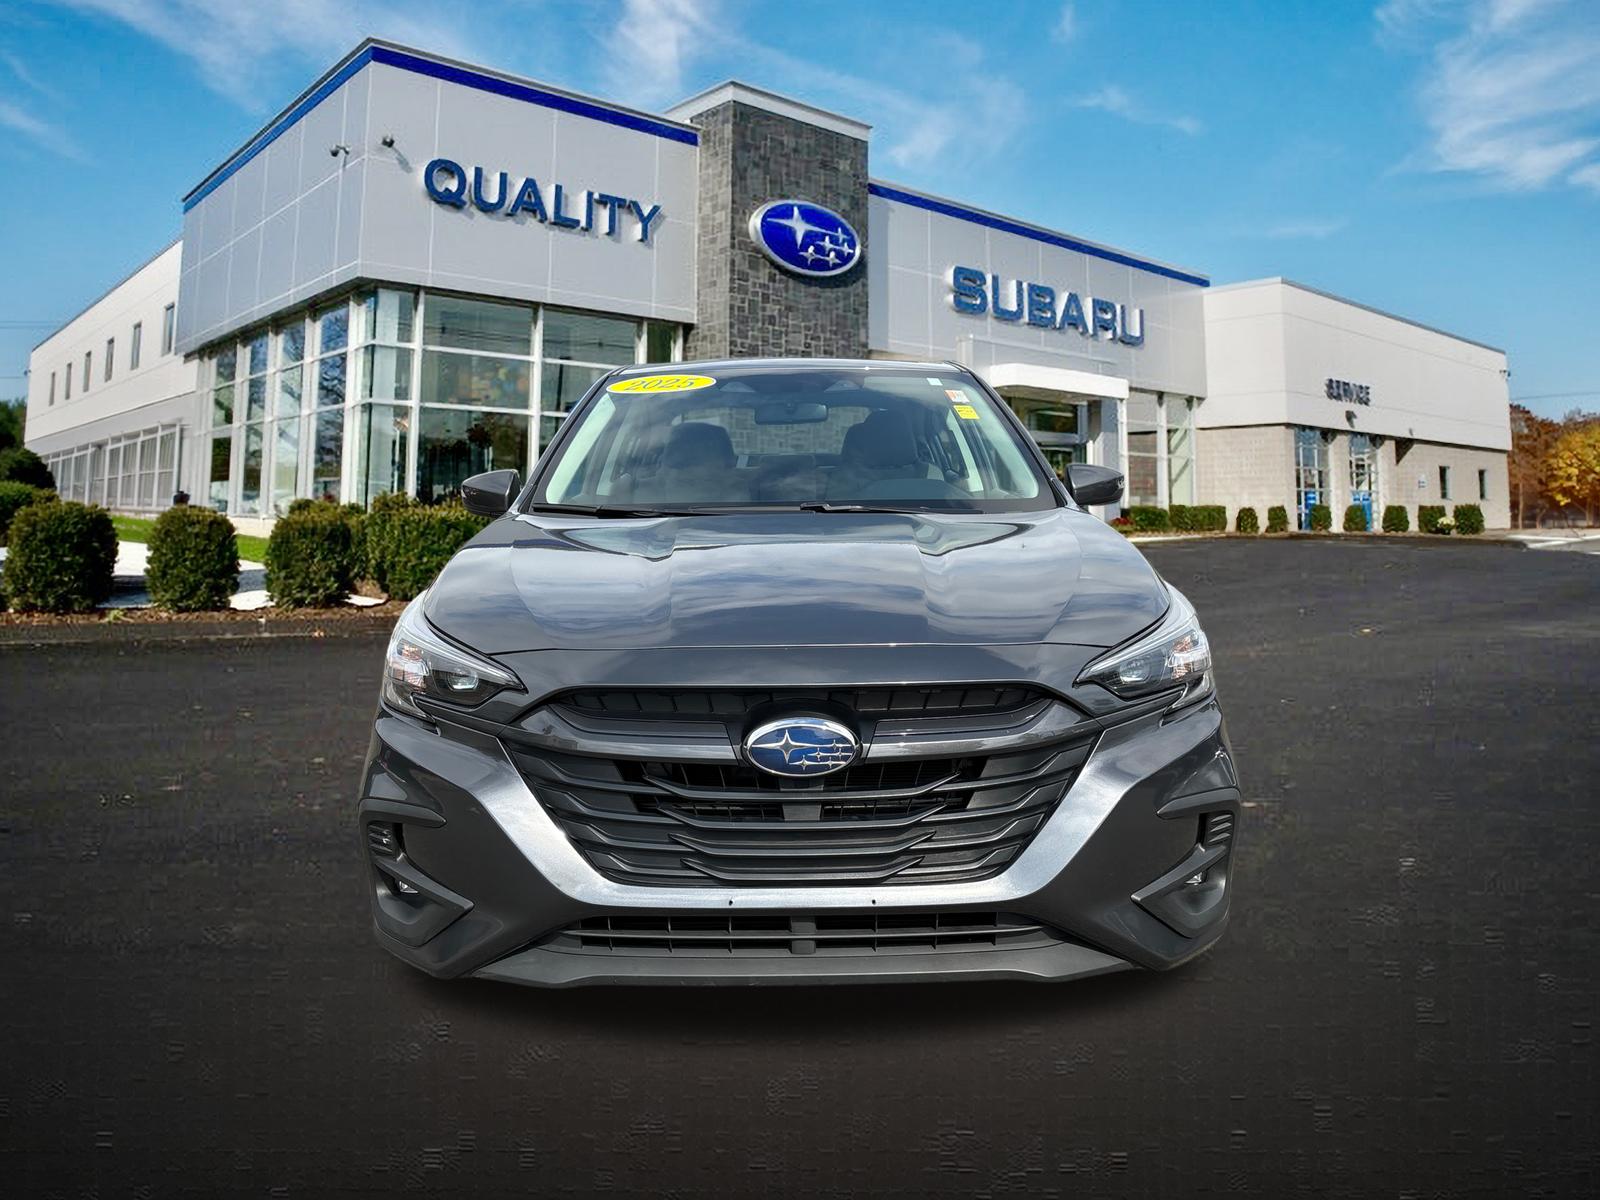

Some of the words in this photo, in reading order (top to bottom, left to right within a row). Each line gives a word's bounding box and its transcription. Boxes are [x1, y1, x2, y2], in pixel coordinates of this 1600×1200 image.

[424, 158, 662, 242] QUALITY
[949, 265, 1145, 346] SUBARU
[624, 376, 701, 391] 2025
[1325, 378, 1371, 406] SERVICE
